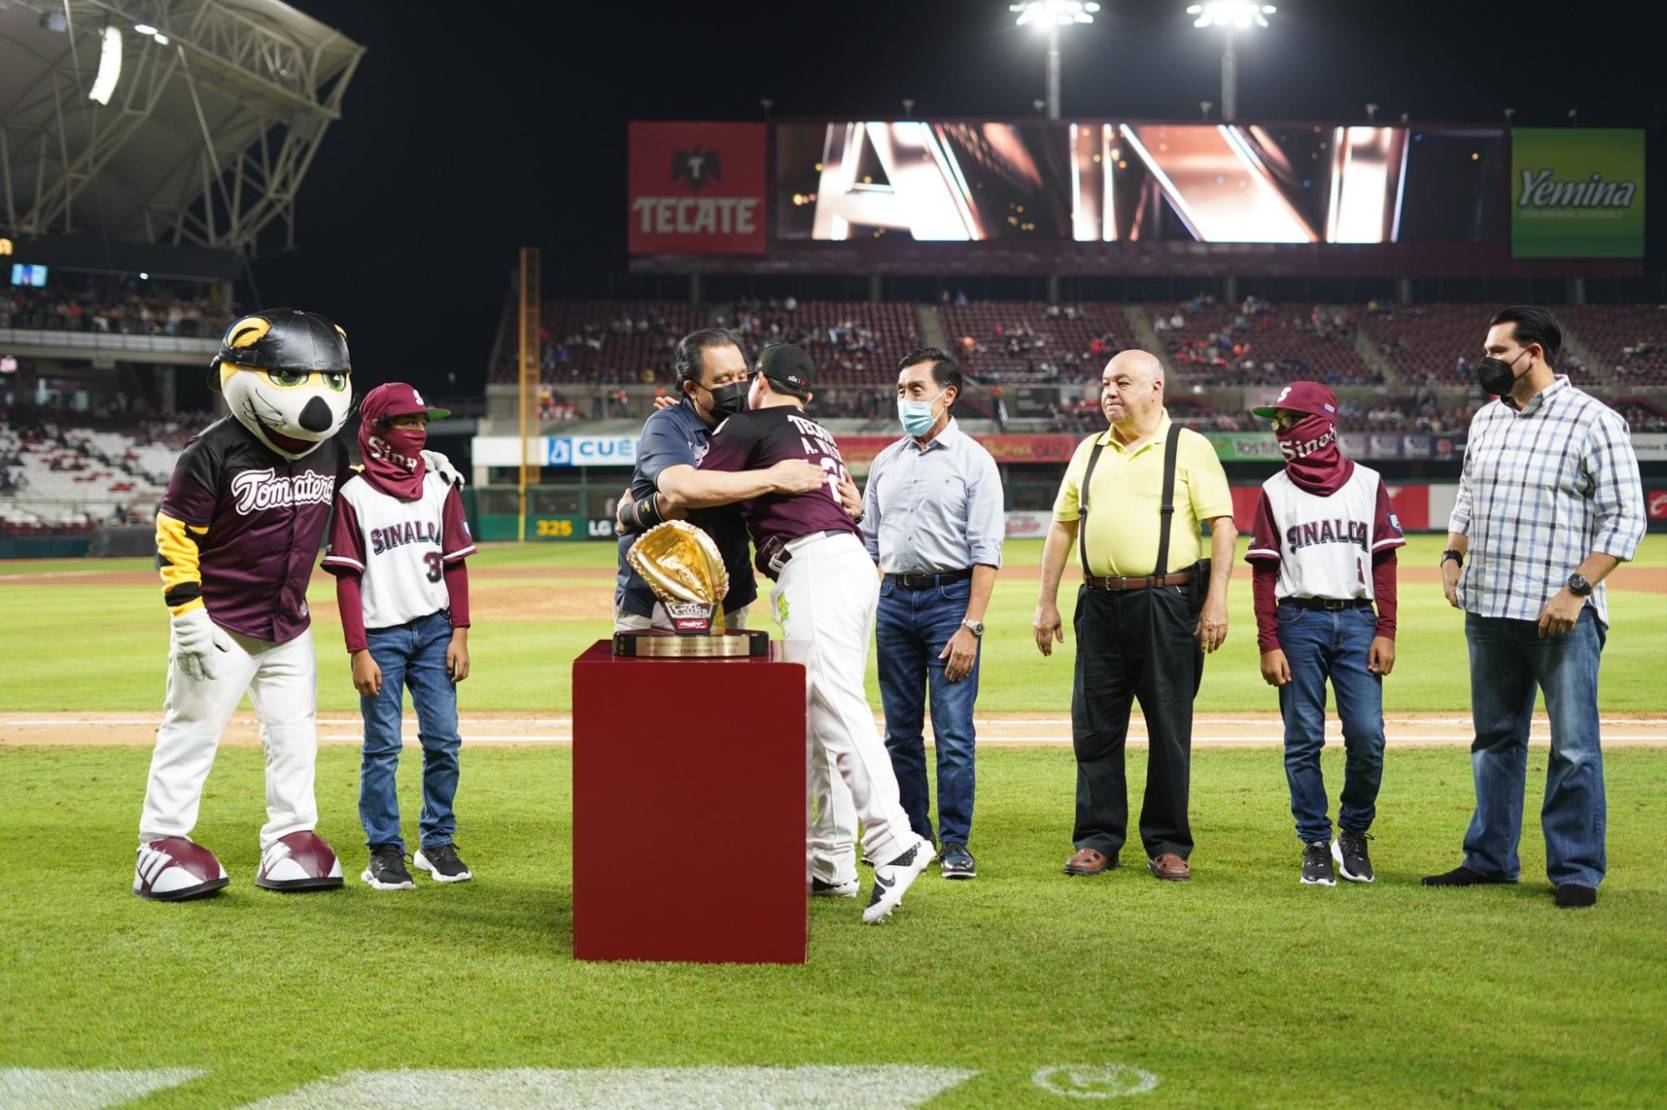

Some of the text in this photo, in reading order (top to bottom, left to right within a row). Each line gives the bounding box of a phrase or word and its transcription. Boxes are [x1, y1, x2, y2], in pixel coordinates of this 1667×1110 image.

[1518, 168, 1637, 208] Yemina
[633, 196, 759, 235] TECATE
[578, 436, 639, 457] CUÉ
[536, 519, 573, 537] 325
[588, 519, 613, 537] LG
